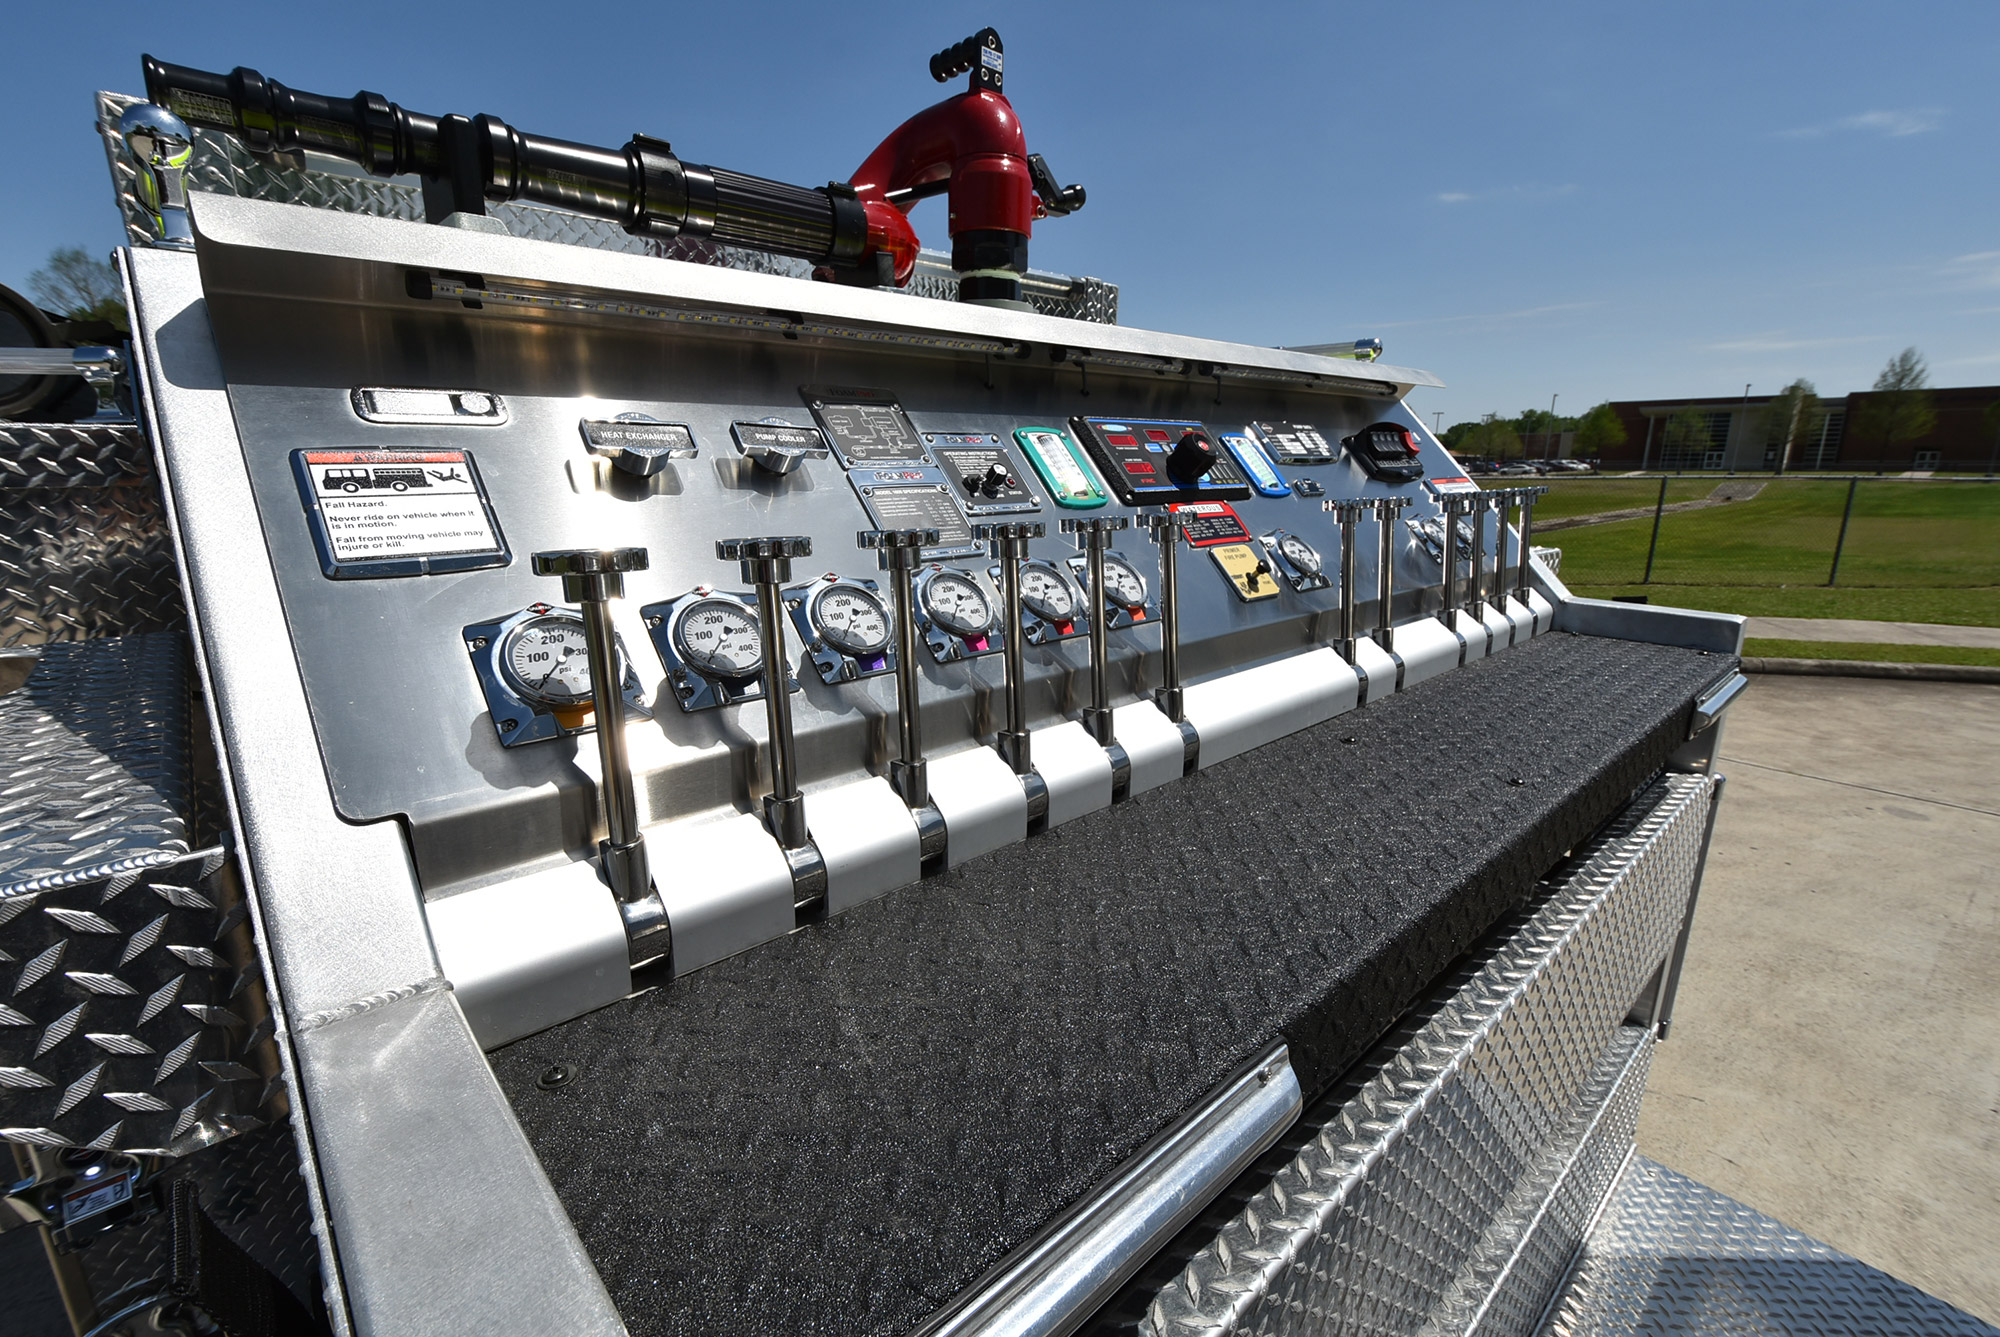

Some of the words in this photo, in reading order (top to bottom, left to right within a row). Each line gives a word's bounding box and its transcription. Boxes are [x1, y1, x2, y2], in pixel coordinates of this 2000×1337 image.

[600, 431, 623, 439] HEAT
[626, 432, 677, 441] EXCHANGER
[325, 501, 345, 509] Fall
[329, 515, 361, 523] Never
[336, 536, 356, 544] Fall
[386, 533, 425, 541] moving
[463, 530, 484, 538] may
[338, 543, 369, 552] injure
[835, 599, 851, 607] 200
[829, 612, 844, 620] 100
[860, 608, 872, 616] 300
[704, 615, 723, 625] 200
[733, 626, 748, 635] 300
[541, 634, 564, 645] 200
[695, 630, 713, 641] 100
[721, 642, 732, 651] psi
[738, 643, 753, 652] 400
[575, 648, 588, 656] 30
[526, 651, 549, 663] 100
[559, 665, 572, 674] psi
